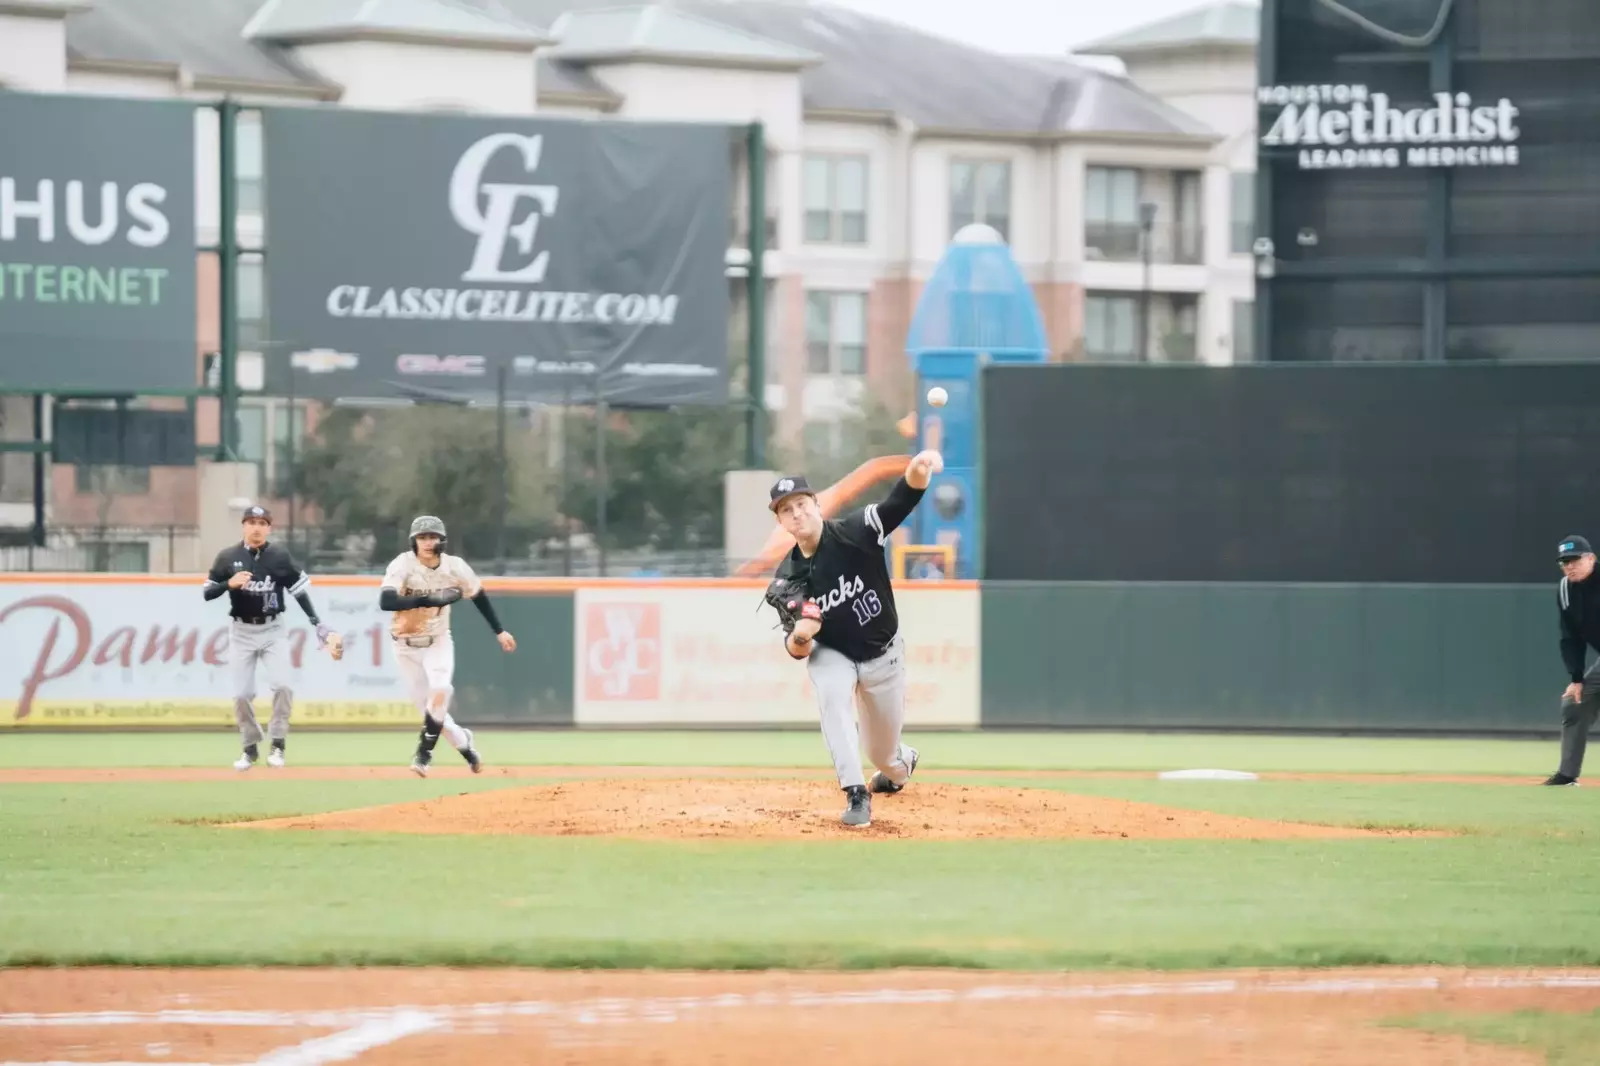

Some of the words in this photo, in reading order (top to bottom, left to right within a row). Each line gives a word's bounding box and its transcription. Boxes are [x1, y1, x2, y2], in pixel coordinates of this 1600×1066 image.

[1258, 84, 1367, 105] HOUSTON
[1261, 92, 1520, 145] Methodist
[1298, 148, 1400, 169] LEADING
[1407, 146, 1520, 167] MEDICINE
[327, 285, 678, 324] CLASSICELITE.COM
[262, 592, 279, 612] 14
[811, 575, 864, 613] acks
[852, 589, 881, 626] 16
